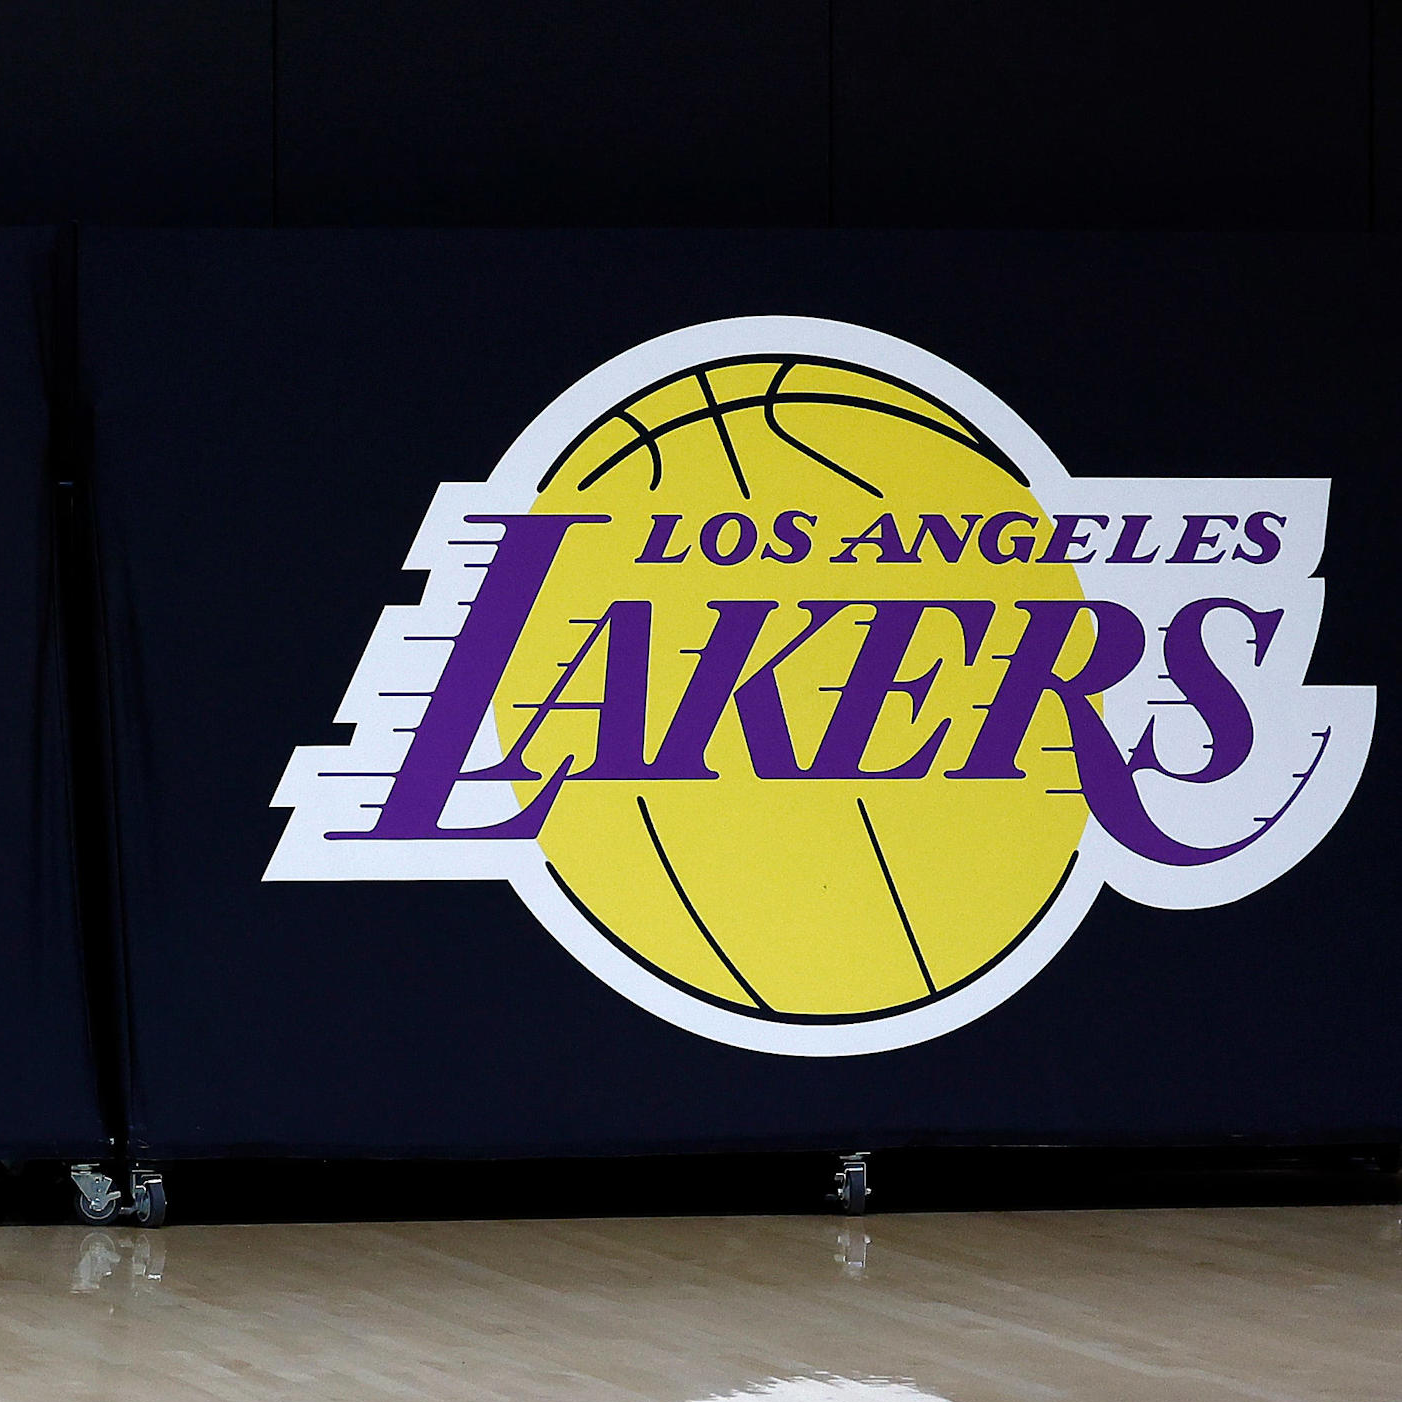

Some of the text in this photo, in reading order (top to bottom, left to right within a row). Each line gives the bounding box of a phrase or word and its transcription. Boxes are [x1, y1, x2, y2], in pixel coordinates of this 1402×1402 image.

[636, 512, 1282, 565] LOS ANGELES
[319, 514, 1332, 867] LAKERS
